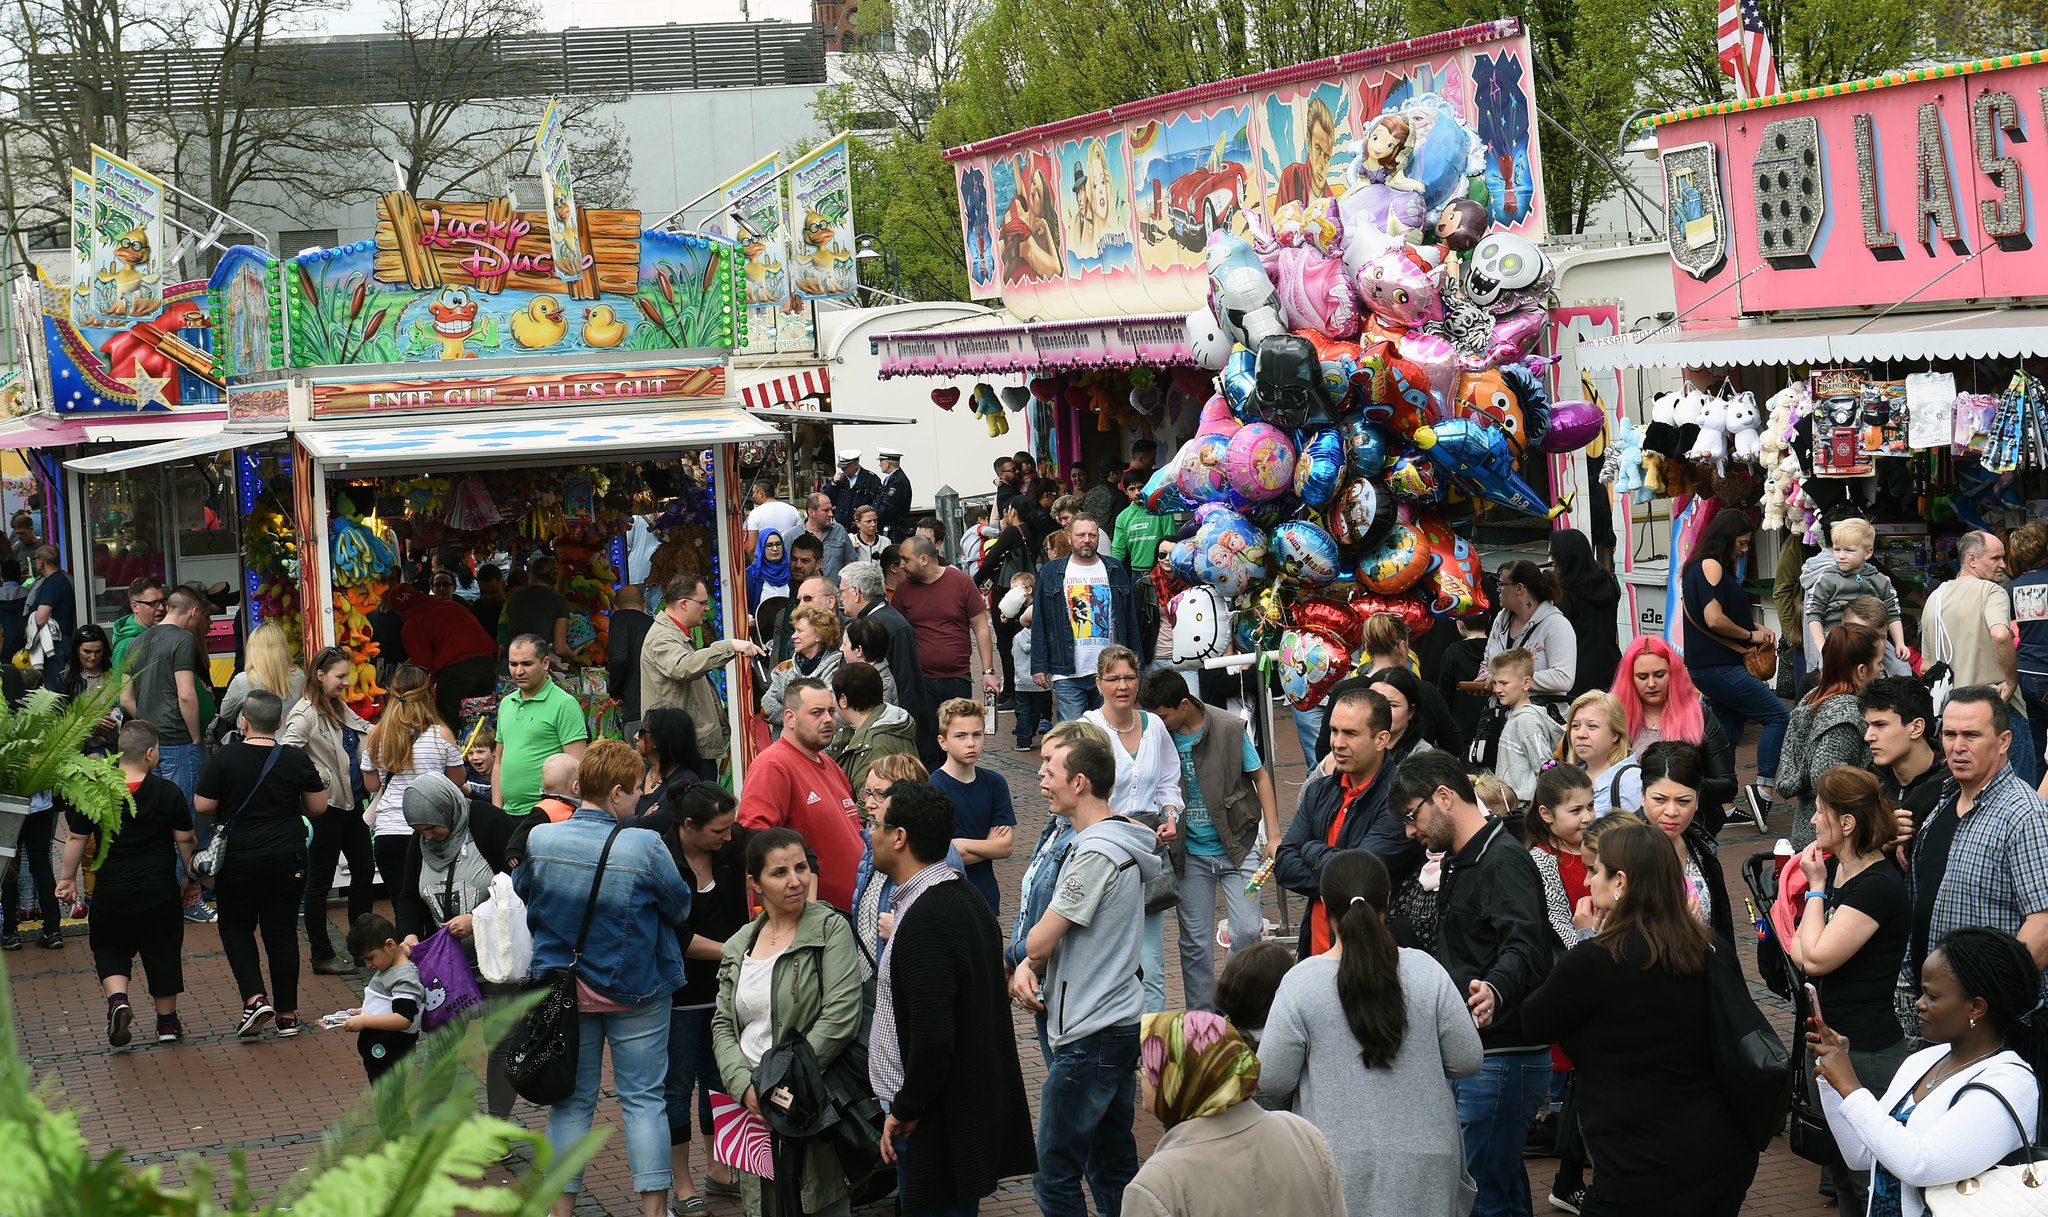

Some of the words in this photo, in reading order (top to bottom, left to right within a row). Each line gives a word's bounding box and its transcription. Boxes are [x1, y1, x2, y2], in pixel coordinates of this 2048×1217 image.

[100, 164, 154, 203] Lucky
[796, 153, 842, 186] Lucky
[1852, 86, 2048, 249] LAS
[100, 187, 155, 227] Ducky
[797, 174, 844, 207] Ducky
[421, 209, 531, 250] Lucky
[1096, 232, 1126, 257] HOLLYWOOD
[452, 238, 594, 286] Duc
[368, 391, 433, 411] ENTE
[443, 387, 496, 406] GUT
[524, 381, 607, 402] ALLES
[614, 378, 667, 397] GUT
[445, 993, 468, 1013] Hello
